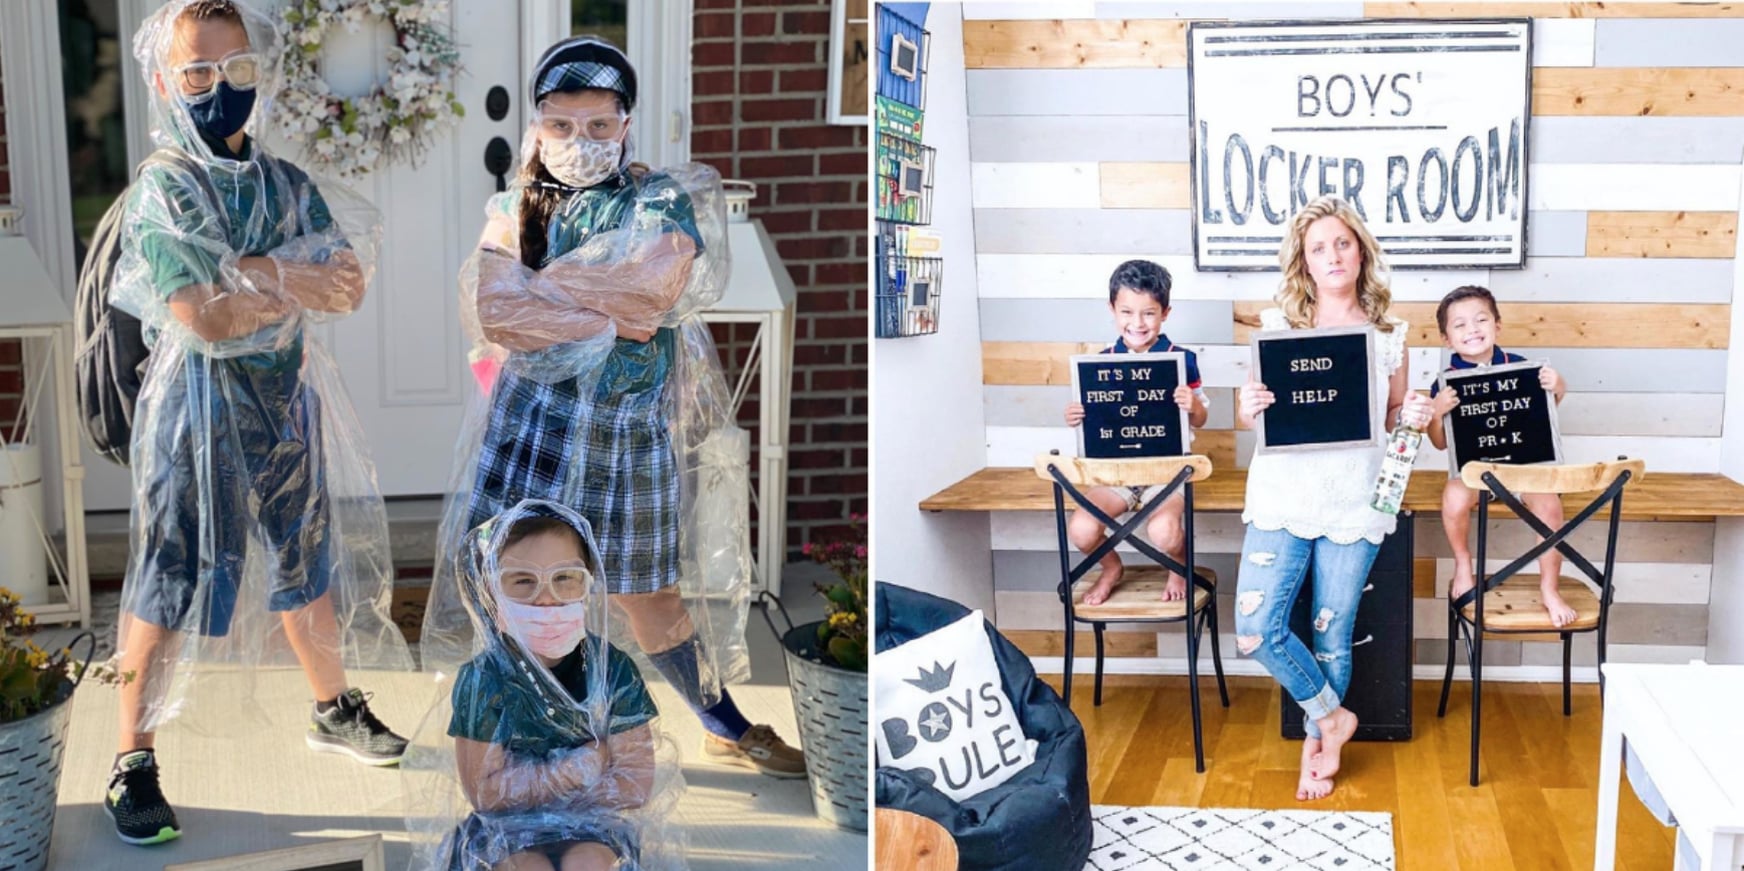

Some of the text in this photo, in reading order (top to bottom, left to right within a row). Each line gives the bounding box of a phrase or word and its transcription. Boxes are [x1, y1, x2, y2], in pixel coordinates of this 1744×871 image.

[1296, 71, 1422, 118] BOYS'
[1199, 115, 1520, 226] LOCKER ROOM
[1290, 357, 1333, 373] SEND
[1097, 368, 1152, 382] IT'S MY
[1462, 378, 1519, 396] IT'S MY
[1086, 389, 1167, 403] FIRST DAY
[1291, 389, 1338, 404] HELP
[1119, 405, 1139, 417] OF
[1460, 396, 1531, 416] FIRST DAY
[1486, 415, 1507, 429] OF
[1120, 425, 1166, 438] GRADE
[881, 682, 1003, 760] BOYS
